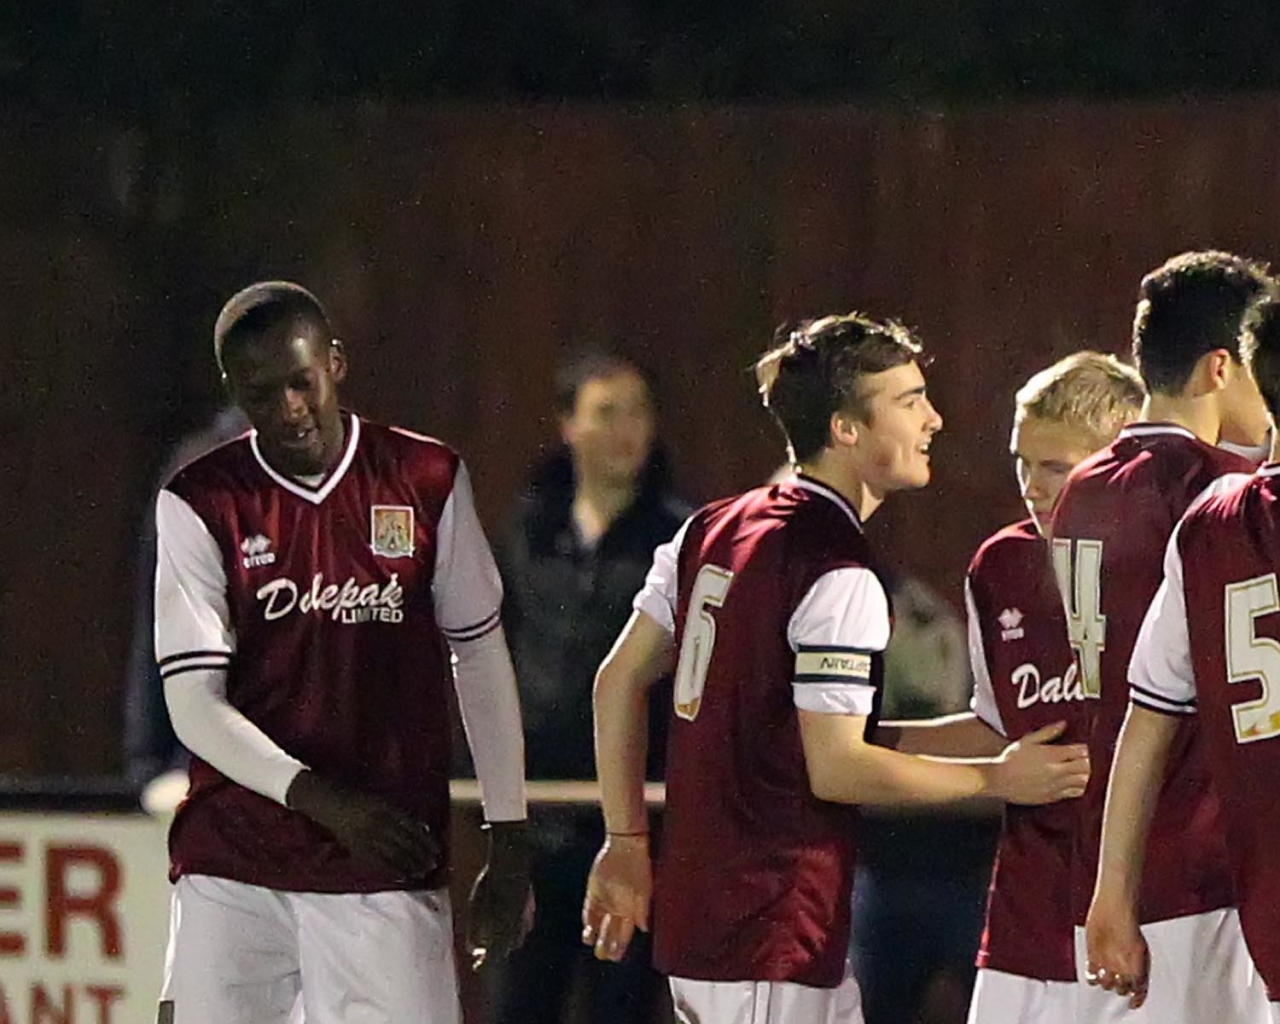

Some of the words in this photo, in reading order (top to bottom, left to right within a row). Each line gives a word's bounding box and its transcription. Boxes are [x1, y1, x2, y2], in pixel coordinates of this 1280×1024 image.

[673, 563, 734, 722] 6
[1011, 663, 1085, 709] Dal
[1052, 537, 1106, 699] 4
